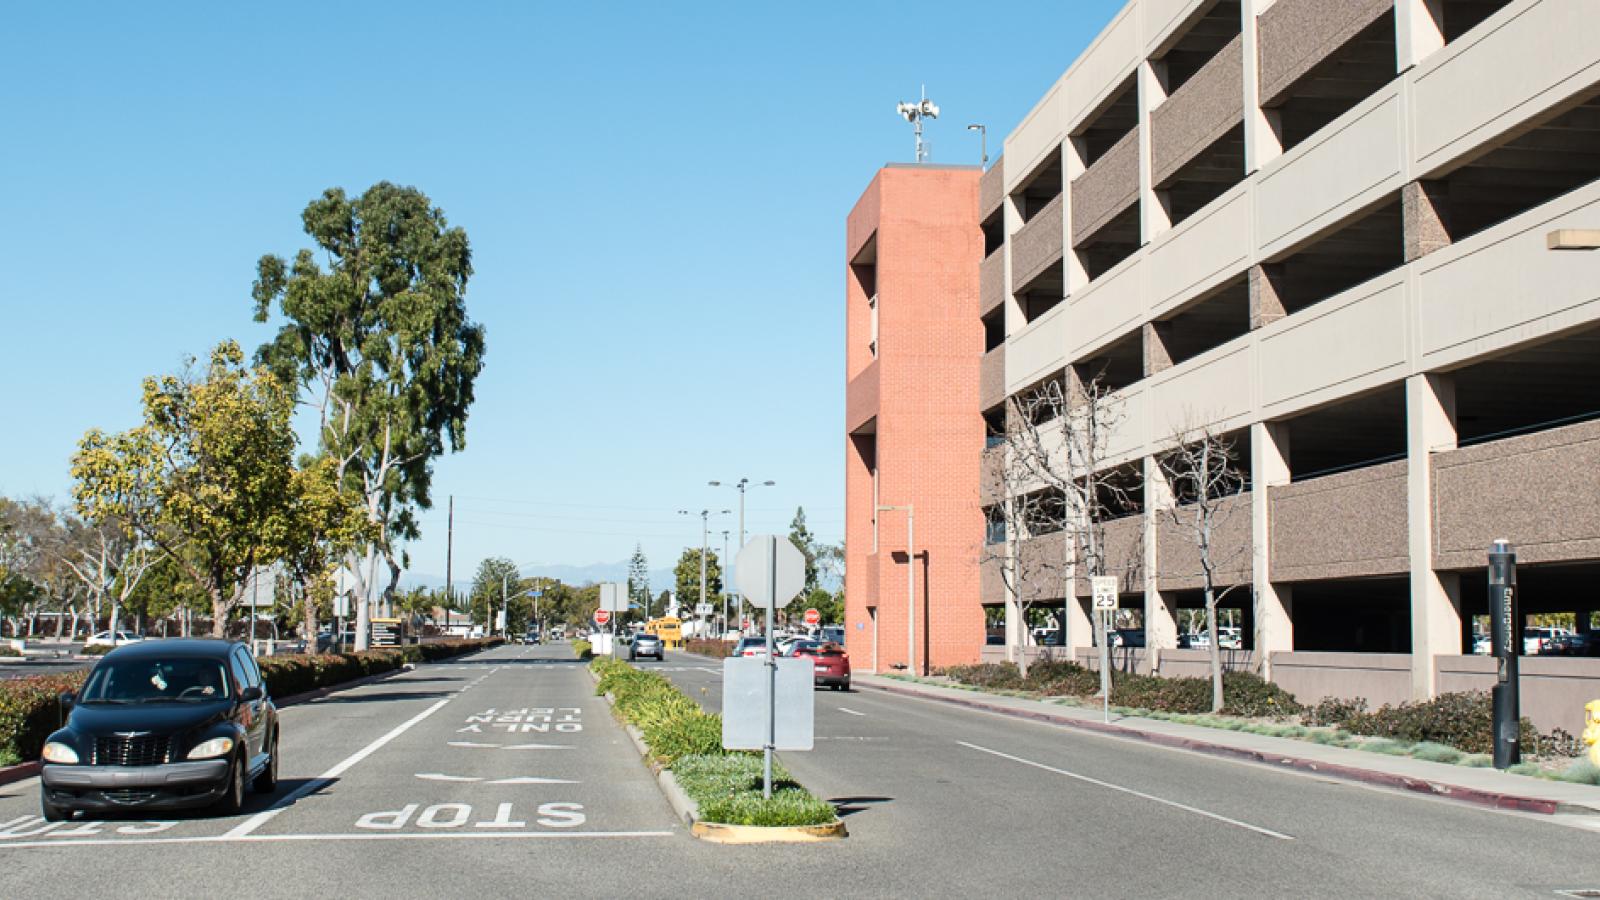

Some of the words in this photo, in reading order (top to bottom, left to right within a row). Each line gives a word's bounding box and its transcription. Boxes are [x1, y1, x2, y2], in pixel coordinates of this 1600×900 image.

[1096, 594, 1115, 606] 25
[480, 707, 582, 715] LEFT
[465, 714, 582, 723] TURN
[456, 722, 583, 733] ONLY
[354, 802, 586, 829] STOP
